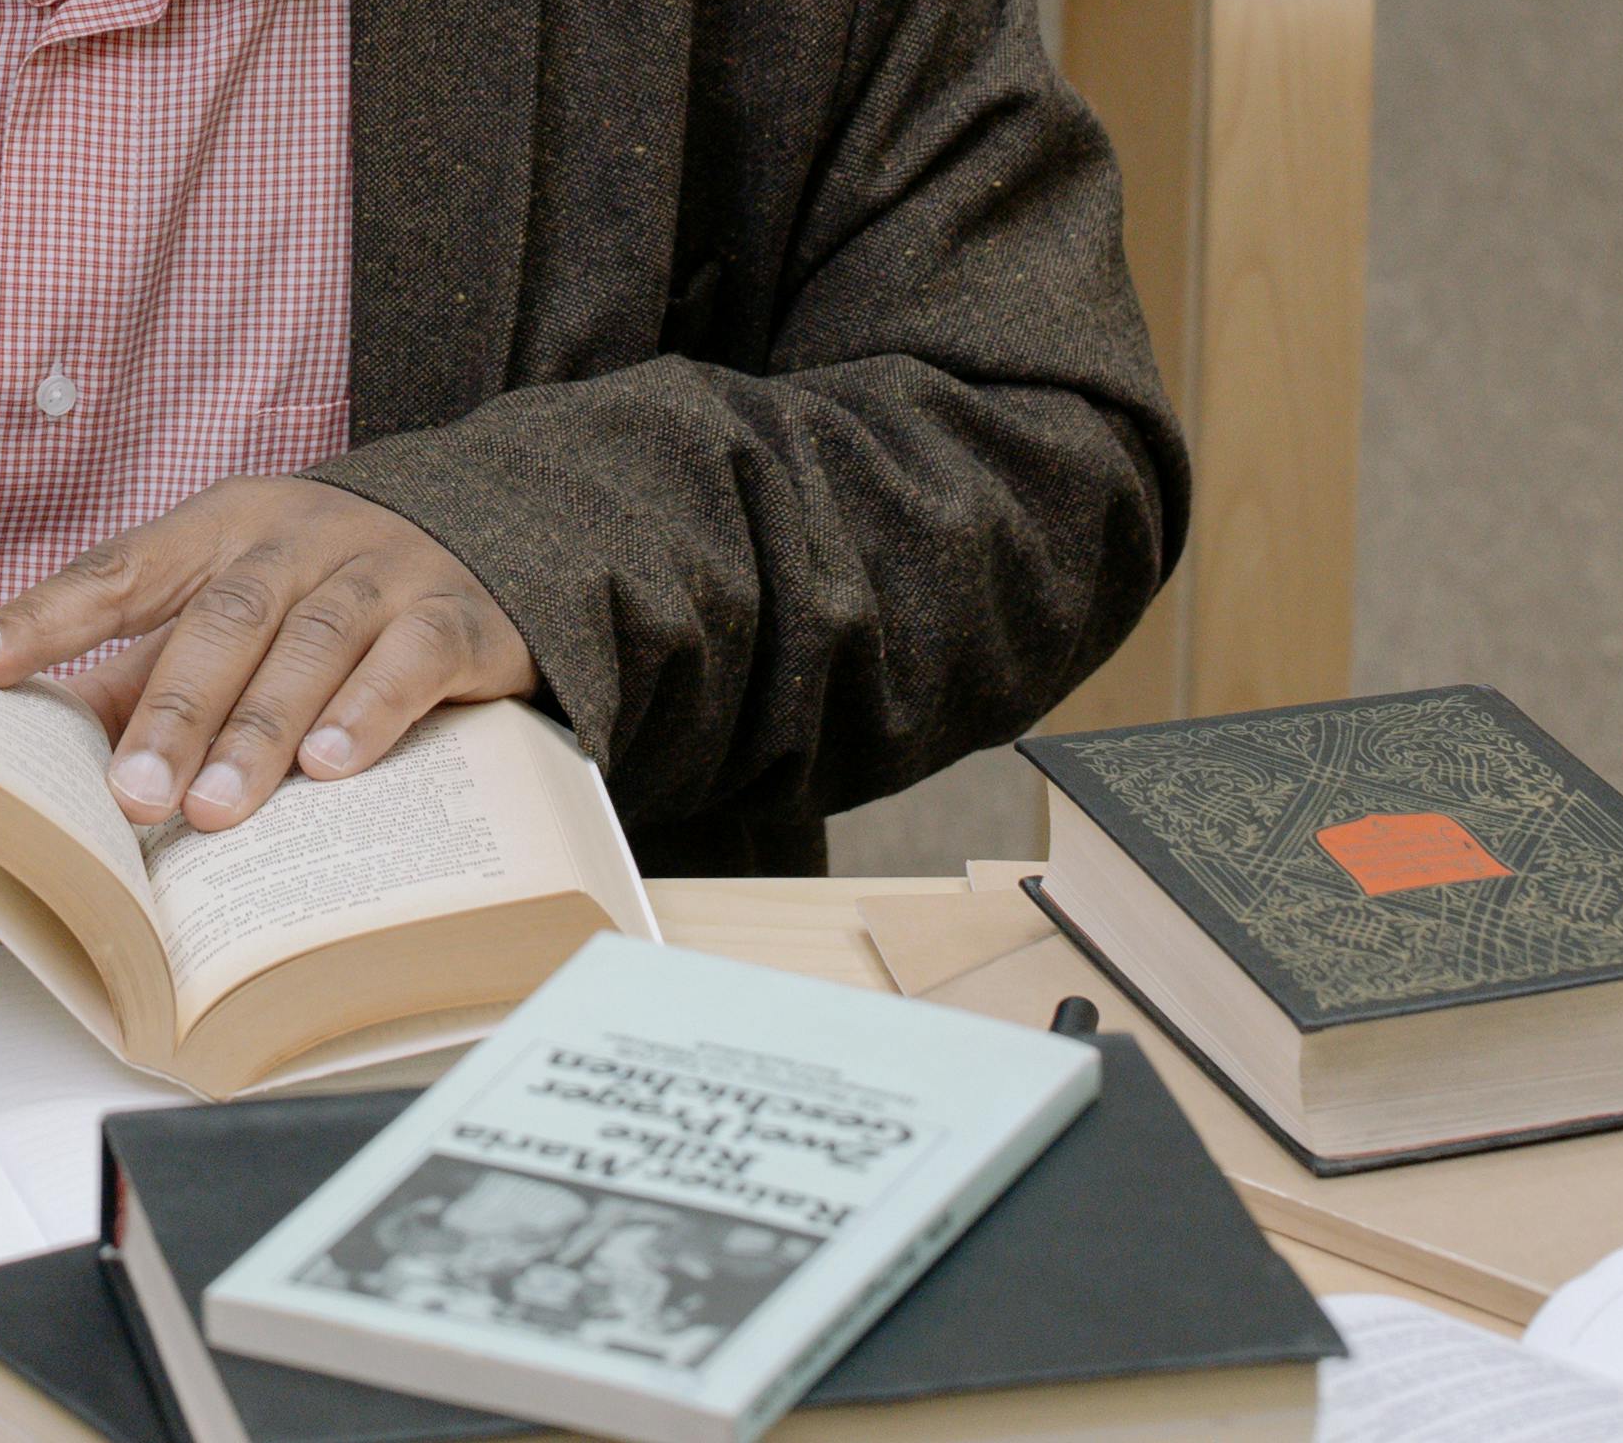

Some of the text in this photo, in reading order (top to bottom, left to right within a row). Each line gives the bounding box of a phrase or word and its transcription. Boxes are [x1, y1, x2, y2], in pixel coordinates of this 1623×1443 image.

[529, 1079, 882, 1175] Zwei Prager
[548, 1049, 914, 1148] Geschichten
[452, 1122, 853, 1228] Rainer Maria
[599, 1124, 758, 1176] Rilke
